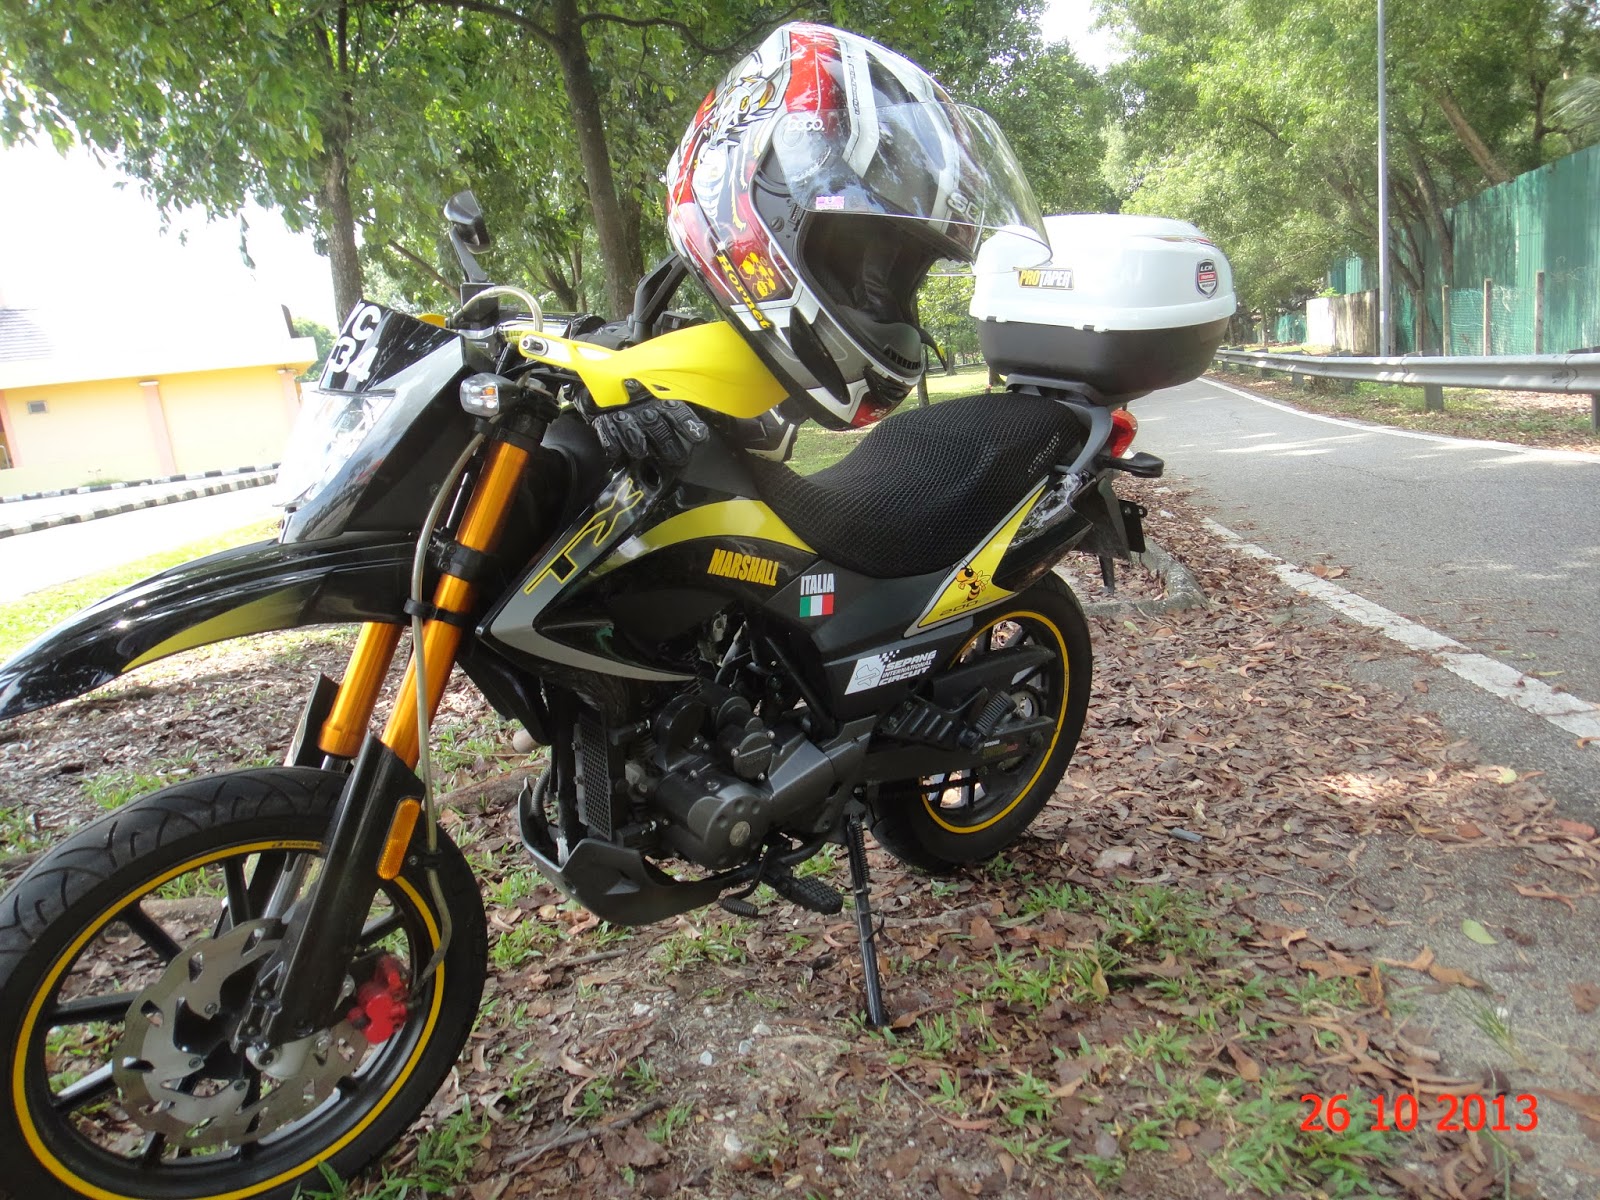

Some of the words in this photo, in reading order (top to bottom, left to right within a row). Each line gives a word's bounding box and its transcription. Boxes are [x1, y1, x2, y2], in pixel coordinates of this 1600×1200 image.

[716, 253, 771, 329] Hornet
[707, 548, 779, 587] MARSHALL
[800, 573, 835, 595] ITALIA
[881, 660, 932, 679] INTERNATIONAL
[884, 649, 937, 672] SEPANG
[878, 666, 930, 687] CIRCUIT
